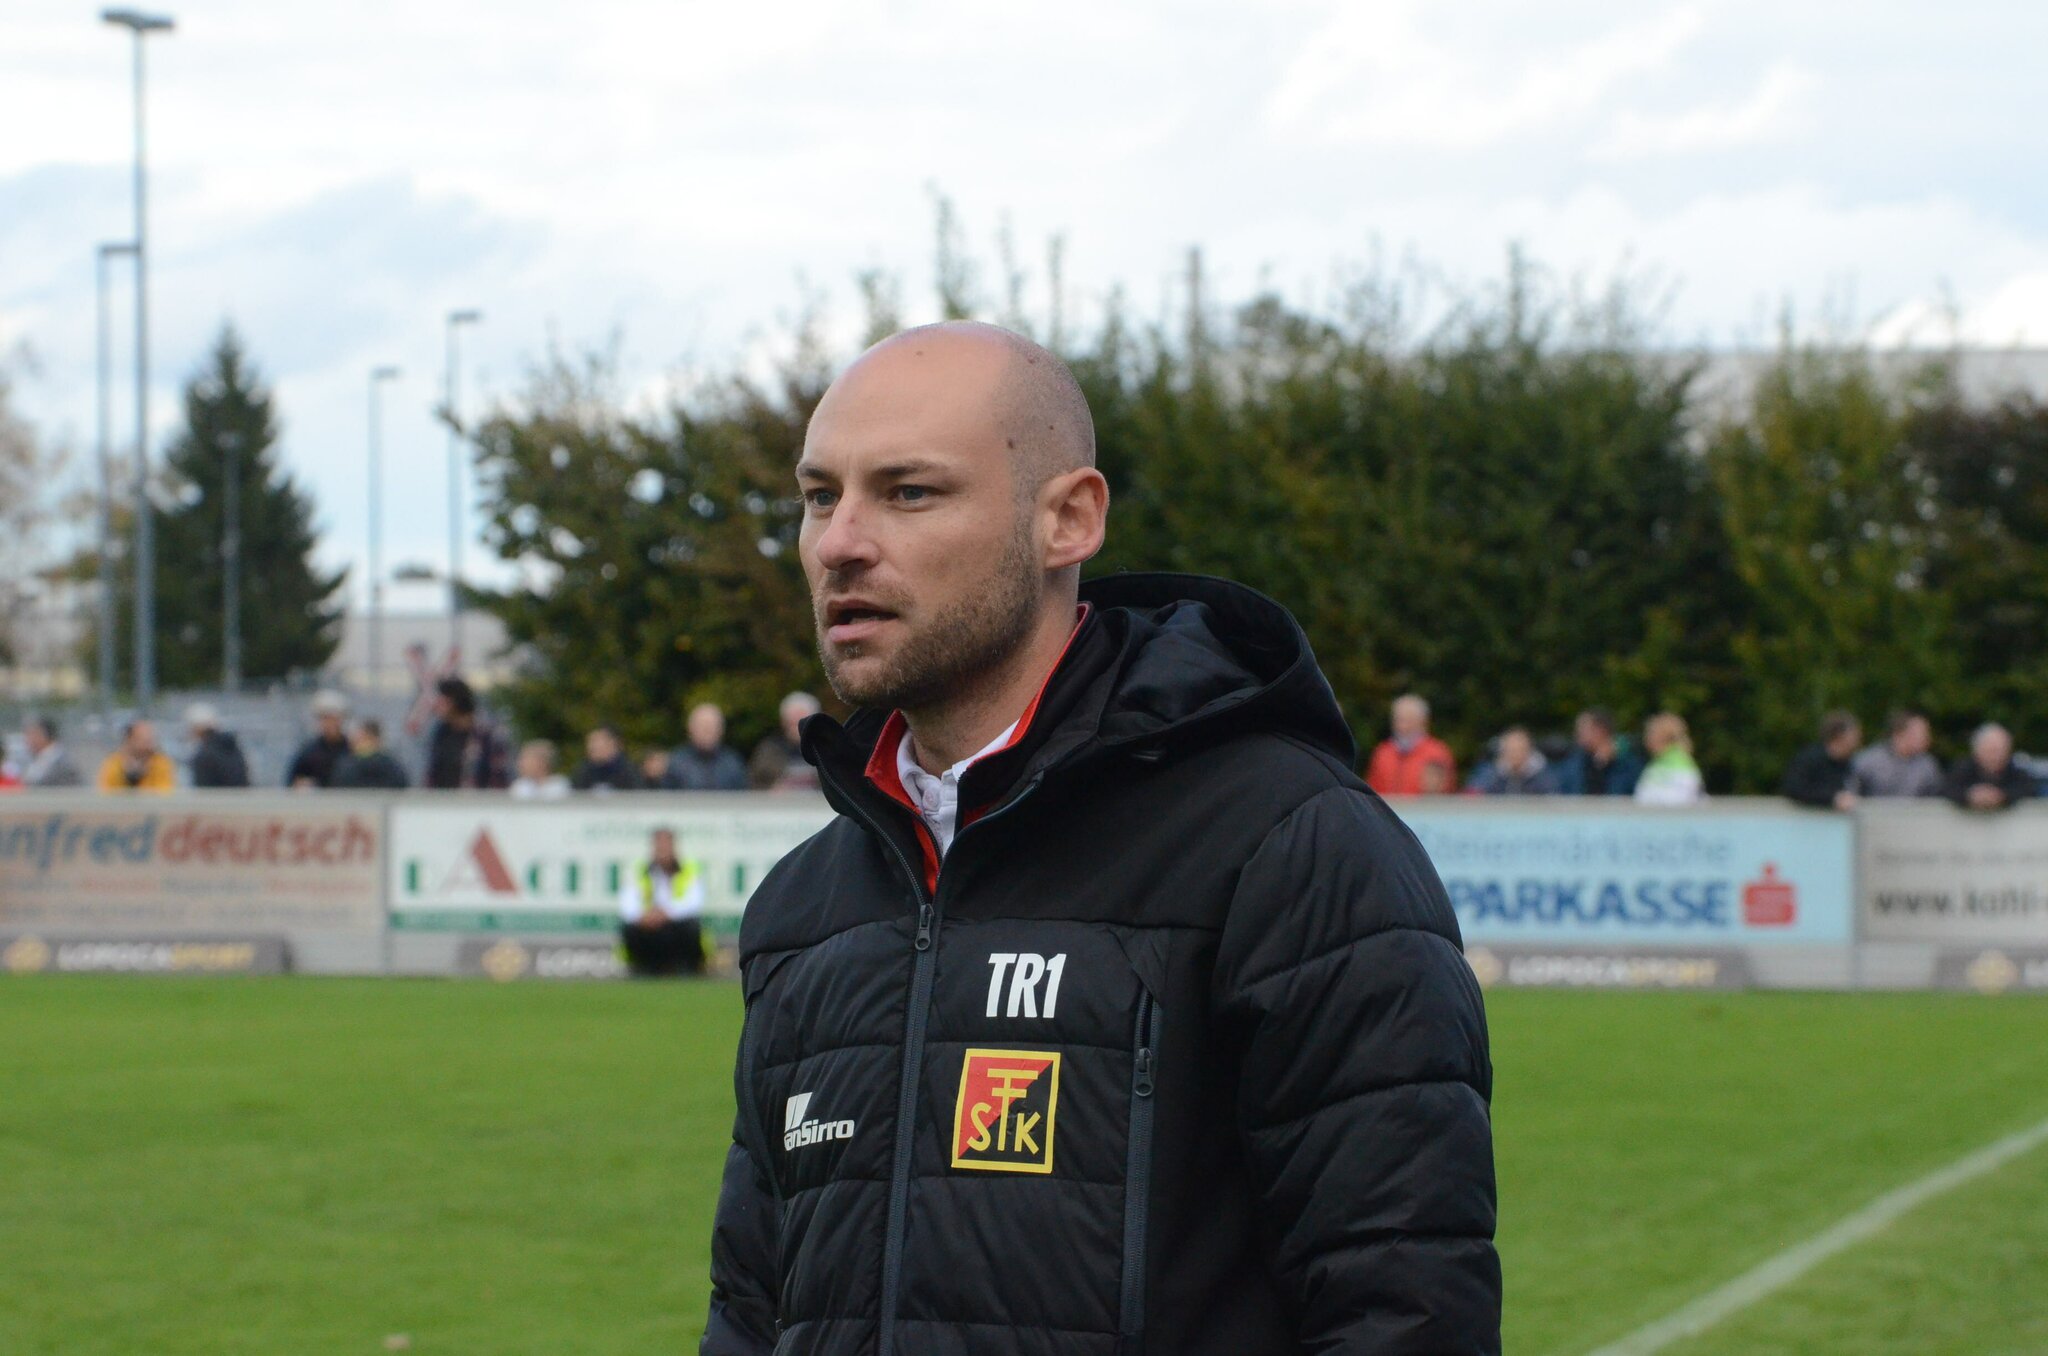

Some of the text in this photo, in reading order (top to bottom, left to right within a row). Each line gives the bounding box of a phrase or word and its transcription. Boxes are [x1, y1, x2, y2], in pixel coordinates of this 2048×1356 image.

[160, 815, 376, 864] deutsch
[1446, 878, 1728, 925] PARKASSE
[986, 953, 1067, 1018] TR1
